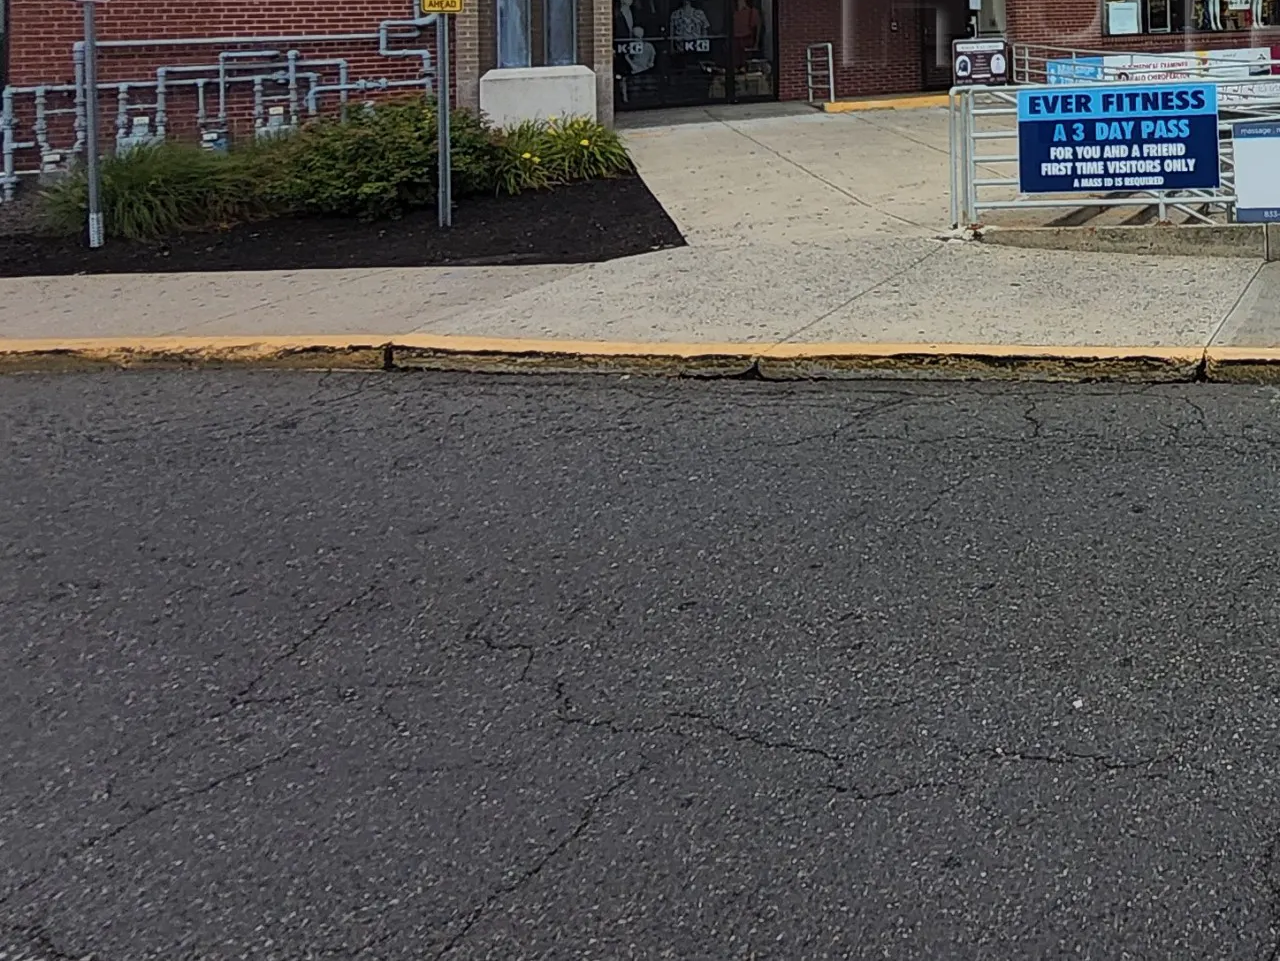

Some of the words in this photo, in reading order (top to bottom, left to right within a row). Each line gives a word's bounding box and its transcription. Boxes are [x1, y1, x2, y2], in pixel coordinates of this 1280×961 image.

[428, 0, 457, 8] AHEAD
[1028, 93, 1092, 115] EVER
[1102, 90, 1206, 112] FITNESS
[1053, 123, 1067, 142] A
[1072, 122, 1085, 141] 3
[1095, 120, 1135, 141] DAY
[1140, 119, 1190, 139] PASS
[1240, 128, 1272, 136] massage
[1050, 146, 1073, 160] FOR
[1075, 145, 1101, 159] YOU
[1103, 144, 1129, 158] AND
[1131, 144, 1140, 158] A
[1143, 143, 1186, 157] FRIEND
[1041, 162, 1073, 176] FIRST
[1075, 161, 1104, 175] TIME
[1106, 159, 1161, 174] VISITORS
[1163, 158, 1196, 173] ONLY
[1073, 179, 1080, 188] A
[1081, 178, 1103, 187] MASS
[1104, 177, 1114, 187] ID
[1114, 177, 1123, 186] IS
[1124, 176, 1164, 186] REQUIRED
